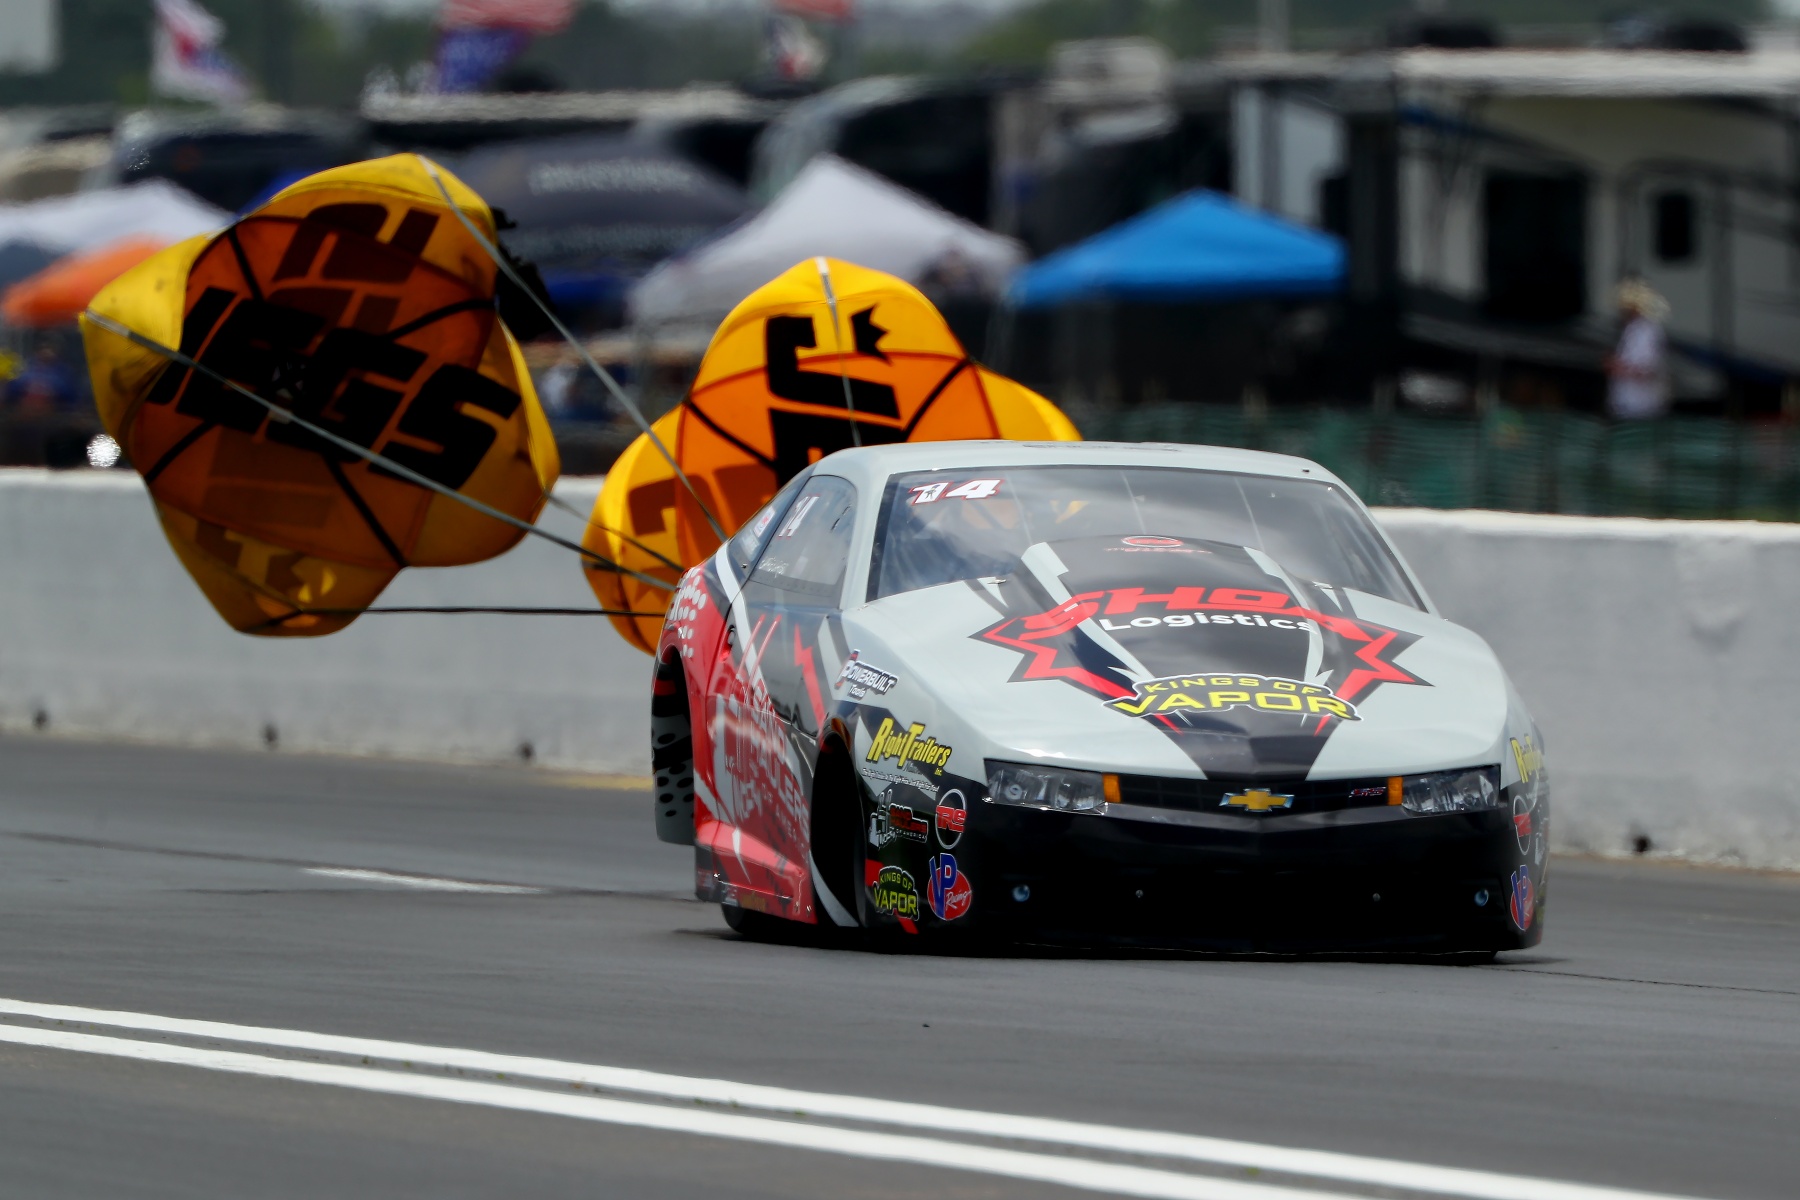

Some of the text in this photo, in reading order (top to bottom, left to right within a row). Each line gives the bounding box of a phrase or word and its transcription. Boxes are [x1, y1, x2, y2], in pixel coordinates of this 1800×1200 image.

[909, 479, 1003, 505] 14
[1100, 611, 1318, 635] Logistics
[842, 660, 895, 693] POWERBUILT
[1145, 677, 1323, 695] KINGS OF
[849, 684, 867, 698] Tools
[1113, 690, 1353, 719] VAPOR
[880, 872, 913, 891] KINGS OF
[928, 852, 958, 920] VP
[874, 886, 917, 915] VAPOR
